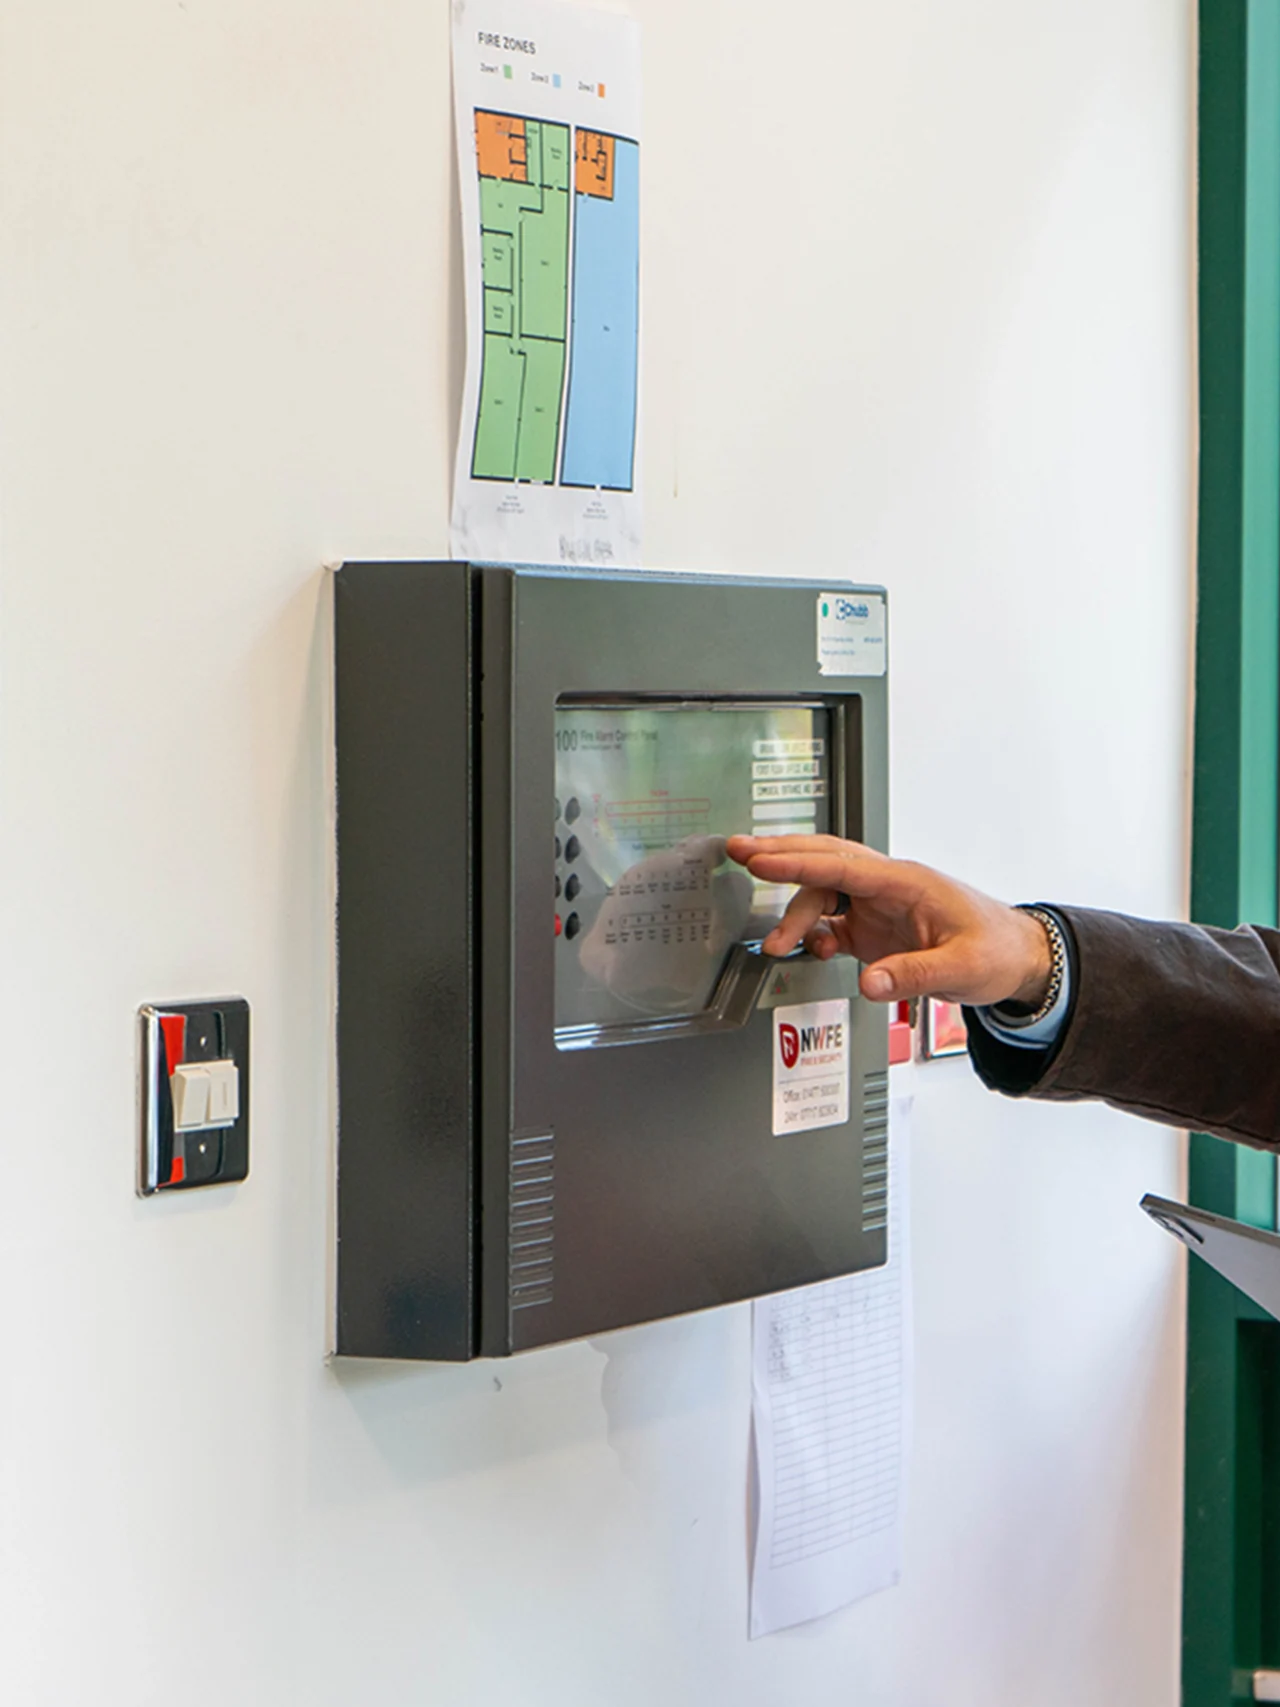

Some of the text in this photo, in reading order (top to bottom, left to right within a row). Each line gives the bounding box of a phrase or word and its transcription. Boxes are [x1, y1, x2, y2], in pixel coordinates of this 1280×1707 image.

[477, 31, 536, 55] FIRE ZONES
[801, 1023, 842, 1053] NWFE
